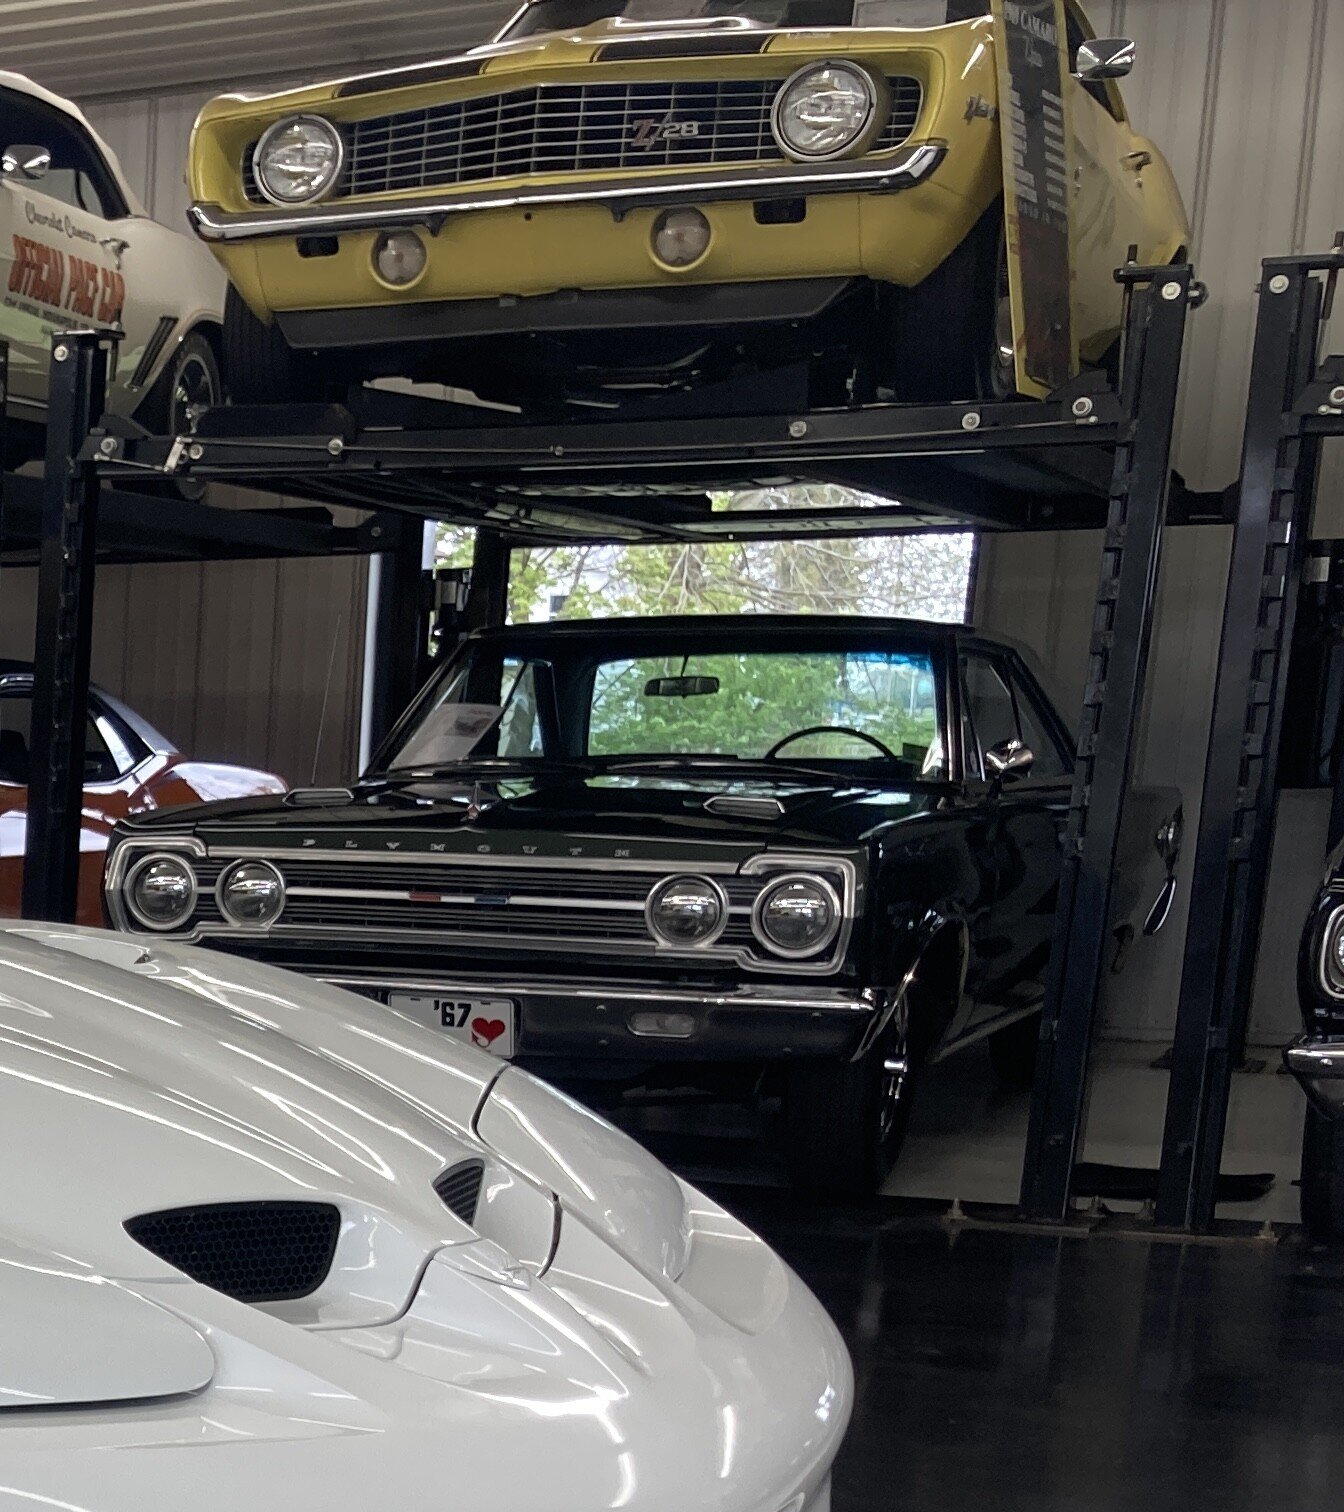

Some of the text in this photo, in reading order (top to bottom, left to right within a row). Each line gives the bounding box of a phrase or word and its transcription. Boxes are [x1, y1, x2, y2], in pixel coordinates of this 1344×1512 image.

[631, 111, 699, 151] Z/28
[64, 255, 99, 318] PACE
[302, 838, 630, 858] PLYMOUTH
[433, 999, 472, 1028] '67
